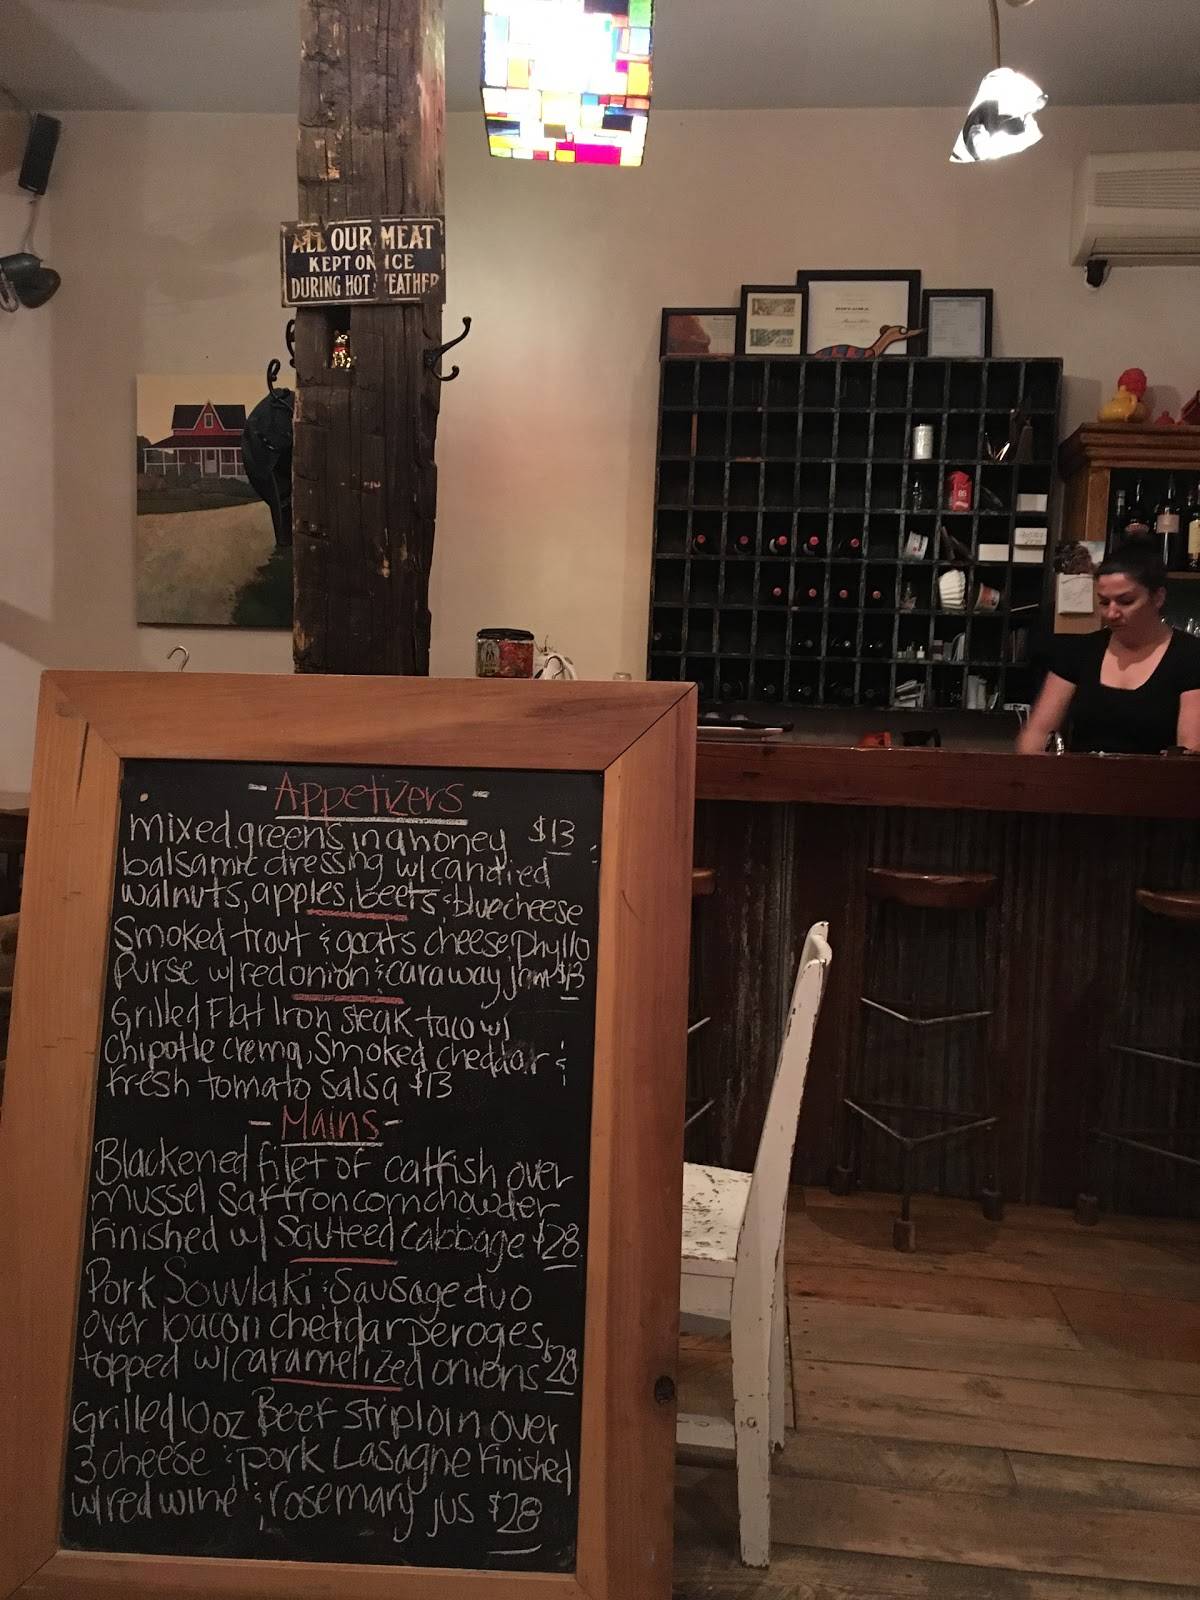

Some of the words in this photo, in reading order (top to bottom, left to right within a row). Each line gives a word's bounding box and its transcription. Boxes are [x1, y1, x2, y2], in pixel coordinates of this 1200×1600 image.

[292, 229, 327, 253] ALL
[331, 226, 372, 252] OUR
[380, 224, 435, 250] MEAT
[309, 255, 352, 273] KEPT
[355, 254, 376, 271] ON
[384, 253, 415, 270] ICE
[291, 276, 340, 299] DURING
[345, 274, 370, 296] HOT
[273, 771, 464, 824] Appetizers
[237, 821, 344, 858] greens
[352, 828, 380, 852] in
[408, 827, 507, 870] honey
[528, 815, 576, 848] $13
[264, 848, 383, 892] dressing
[396, 854, 424, 883] w/
[431, 854, 551, 889] candied
[114, 915, 227, 957] Smoked
[230, 917, 311, 957] trout
[335, 922, 416, 972] goats
[424, 926, 509, 958] cheese
[208, 955, 234, 993] w/
[289, 961, 369, 990] onion
[385, 959, 501, 1009] caraway
[111, 988, 199, 1041] Grilled
[206, 991, 266, 1031] Flat
[273, 995, 332, 1032] Iron
[414, 1005, 475, 1041] taco
[480, 1012, 511, 1042] w/
[198, 1062, 312, 1101] tomato
[409, 1067, 453, 1099] $13
[436, 1038, 549, 1079] cheddar
[280, 1099, 380, 1141] Mains
[94, 1133, 249, 1186] Blackened
[335, 1147, 372, 1180] of
[384, 1145, 497, 1189] catfish
[506, 1158, 575, 1191] over
[230, 1215, 268, 1263] w/
[532, 1218, 580, 1260] $28
[85, 1256, 158, 1310] Pork
[163, 1255, 312, 1309] Souvlaki
[463, 1272, 532, 1312] duo
[83, 1309, 149, 1346] over
[162, 1304, 261, 1344] bacon
[79, 1341, 179, 1393] topped
[194, 1345, 229, 1383] w/
[231, 1345, 424, 1390] caramelized
[431, 1354, 540, 1392] onions
[543, 1337, 578, 1386] $28
[72, 1391, 175, 1448] Grilled
[251, 1386, 338, 1438] Beef
[490, 1409, 560, 1445] over
[73, 1444, 98, 1485] 3
[102, 1440, 212, 1480] cheese
[236, 1435, 326, 1492] pork
[333, 1436, 472, 1495] Lasagne
[71, 1484, 101, 1526] w/
[159, 1487, 238, 1518] wine
[270, 1478, 414, 1543] rosemary
[425, 1491, 475, 1538] jus
[488, 1490, 543, 1533] $28
